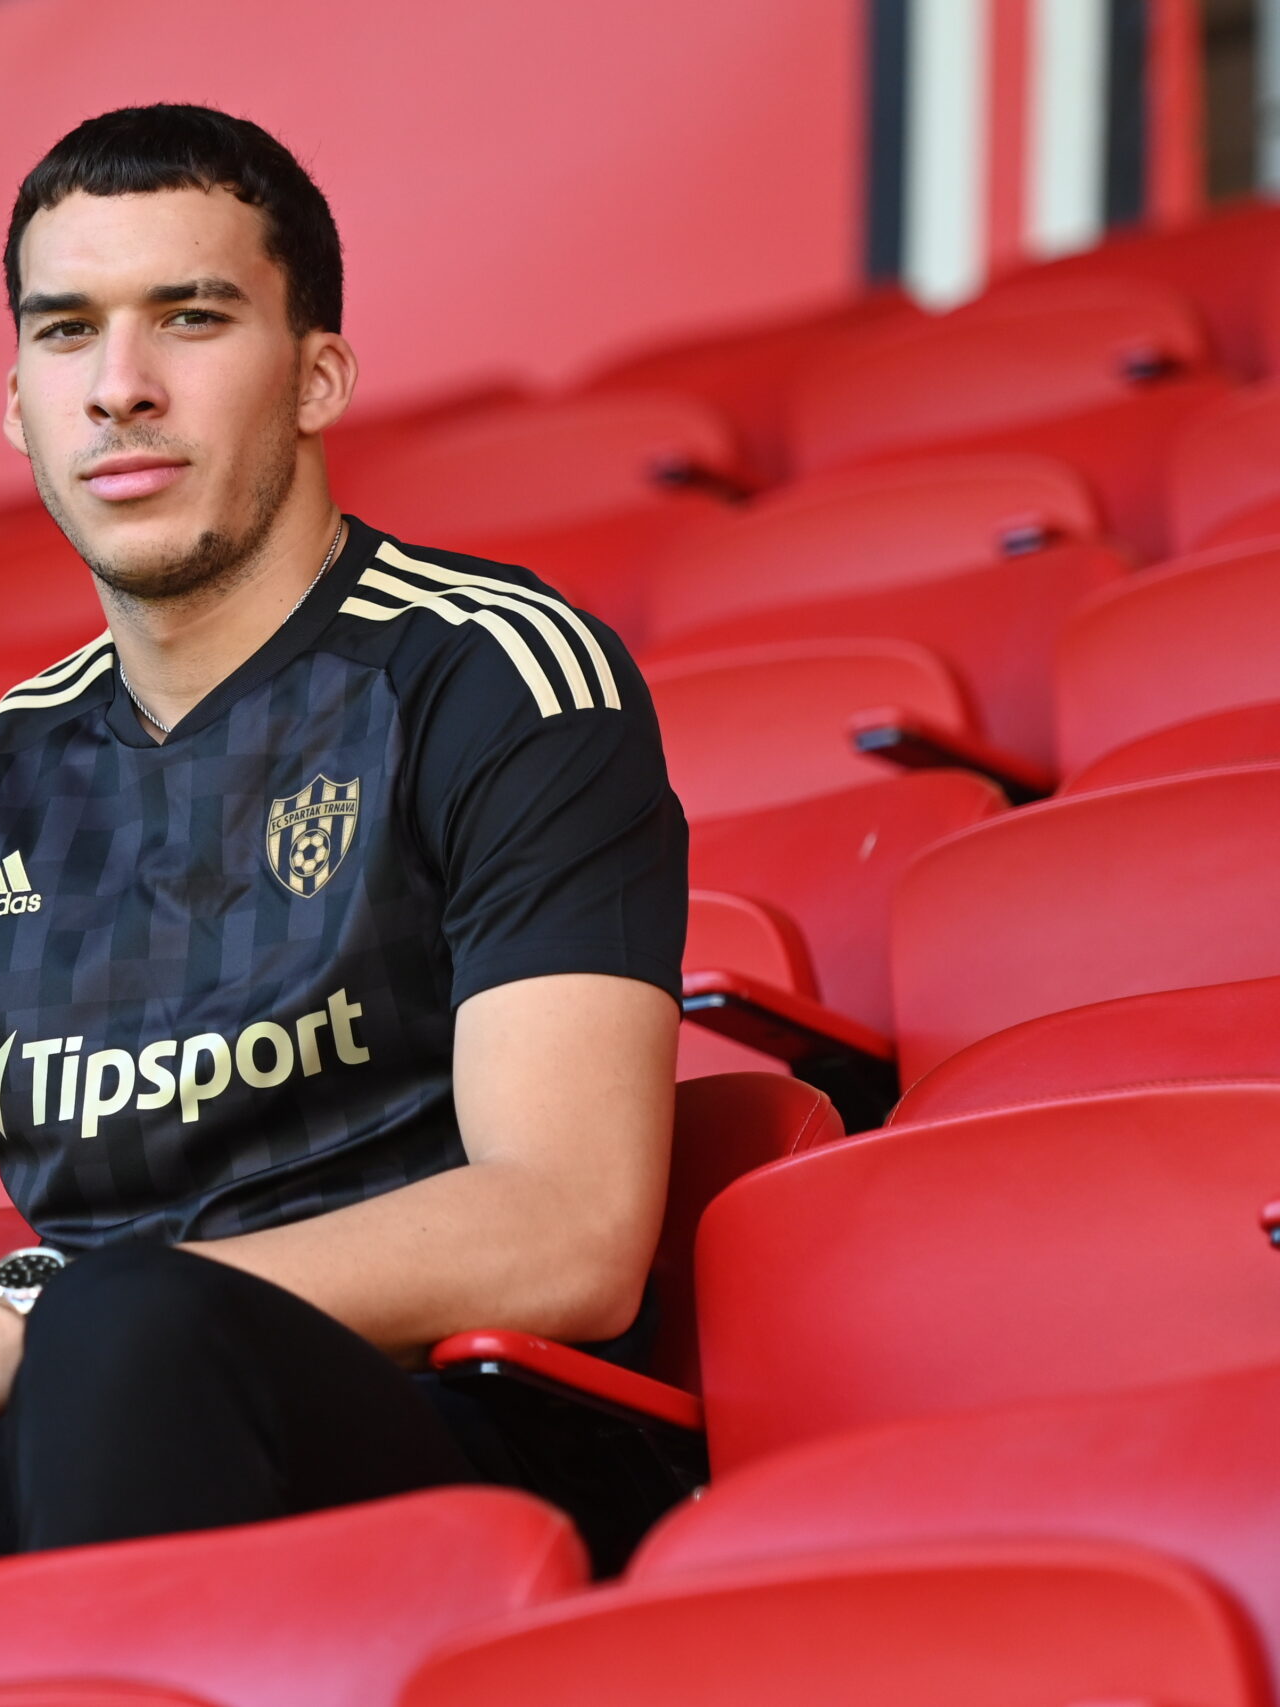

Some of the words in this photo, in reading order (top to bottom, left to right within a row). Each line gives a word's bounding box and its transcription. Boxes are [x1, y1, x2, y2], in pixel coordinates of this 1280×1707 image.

[271, 818, 282, 831] FC
[283, 805, 321, 826] SPARTAK
[323, 802, 355, 814] TRNAVA
[21, 988, 370, 1138] Tipsport
